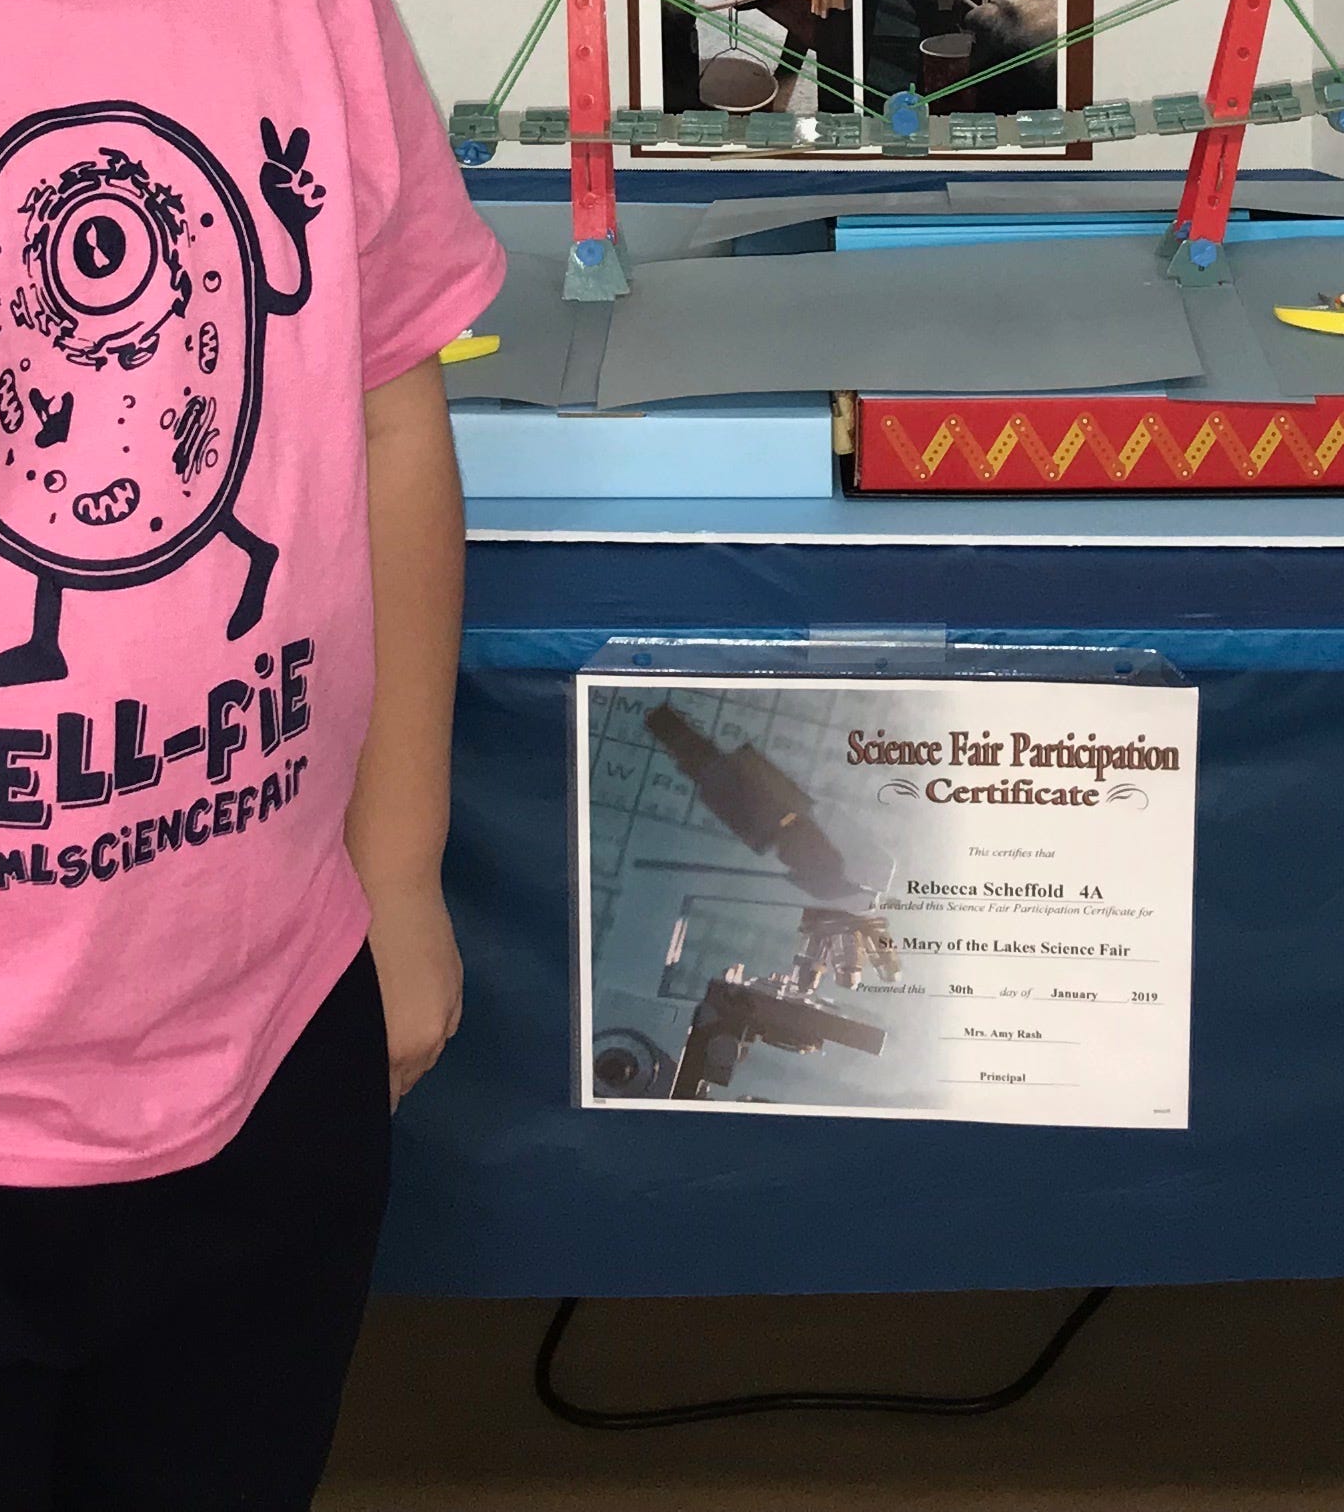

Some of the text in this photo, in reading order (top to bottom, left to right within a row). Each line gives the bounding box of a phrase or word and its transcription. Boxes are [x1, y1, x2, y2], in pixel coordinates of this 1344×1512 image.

[846, 728, 1180, 781] Science Fair Participation
[925, 778, 1100, 806] Certificate
[906, 879, 1102, 898] Rebecca Scheffold 4A
[878, 937, 1129, 956] St. Mary of the Lakes Science Fair
[949, 984, 973, 994] 30th
[1050, 988, 1096, 1001] January
[1131, 991, 1157, 1001] 2019
[990, 1029, 1012, 1040] Amy
[1017, 1029, 1041, 1038] Rash
[980, 1071, 1025, 1084] Principal
